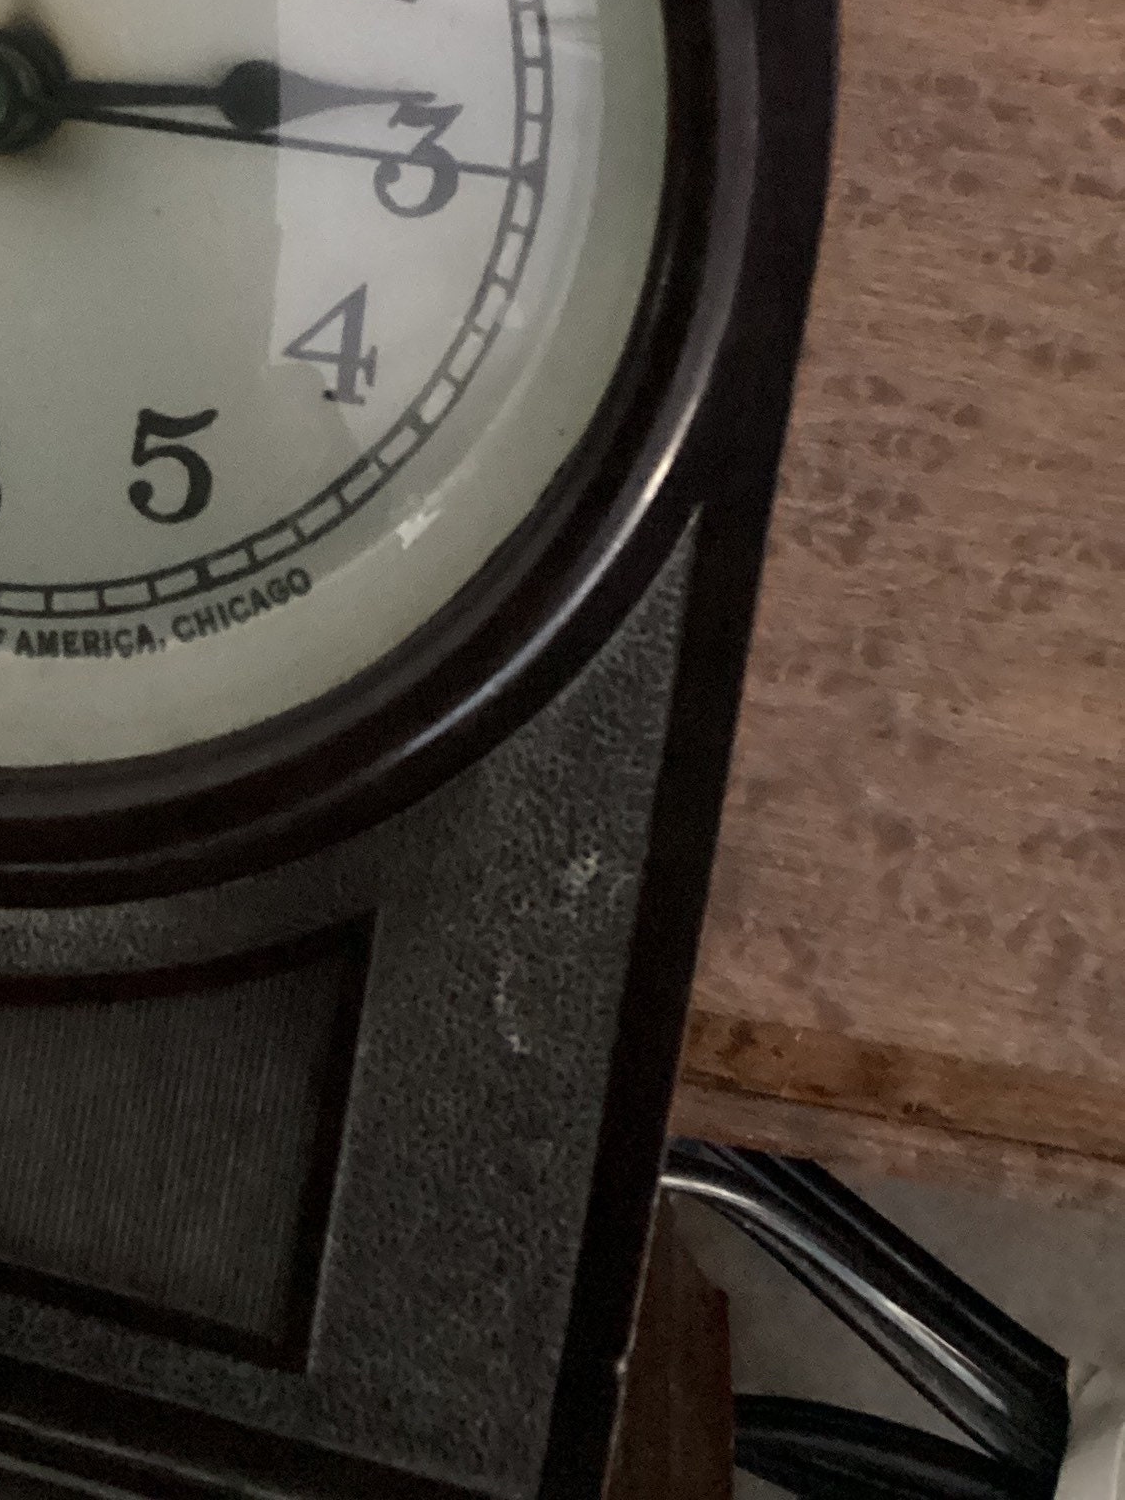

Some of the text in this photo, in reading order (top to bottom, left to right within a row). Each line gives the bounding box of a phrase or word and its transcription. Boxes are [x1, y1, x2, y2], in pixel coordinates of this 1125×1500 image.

[372, 101, 465, 219] 3
[281, 282, 379, 407] 4
[128, 408, 221, 524] 5
[171, 566, 314, 643] CHICAGO
